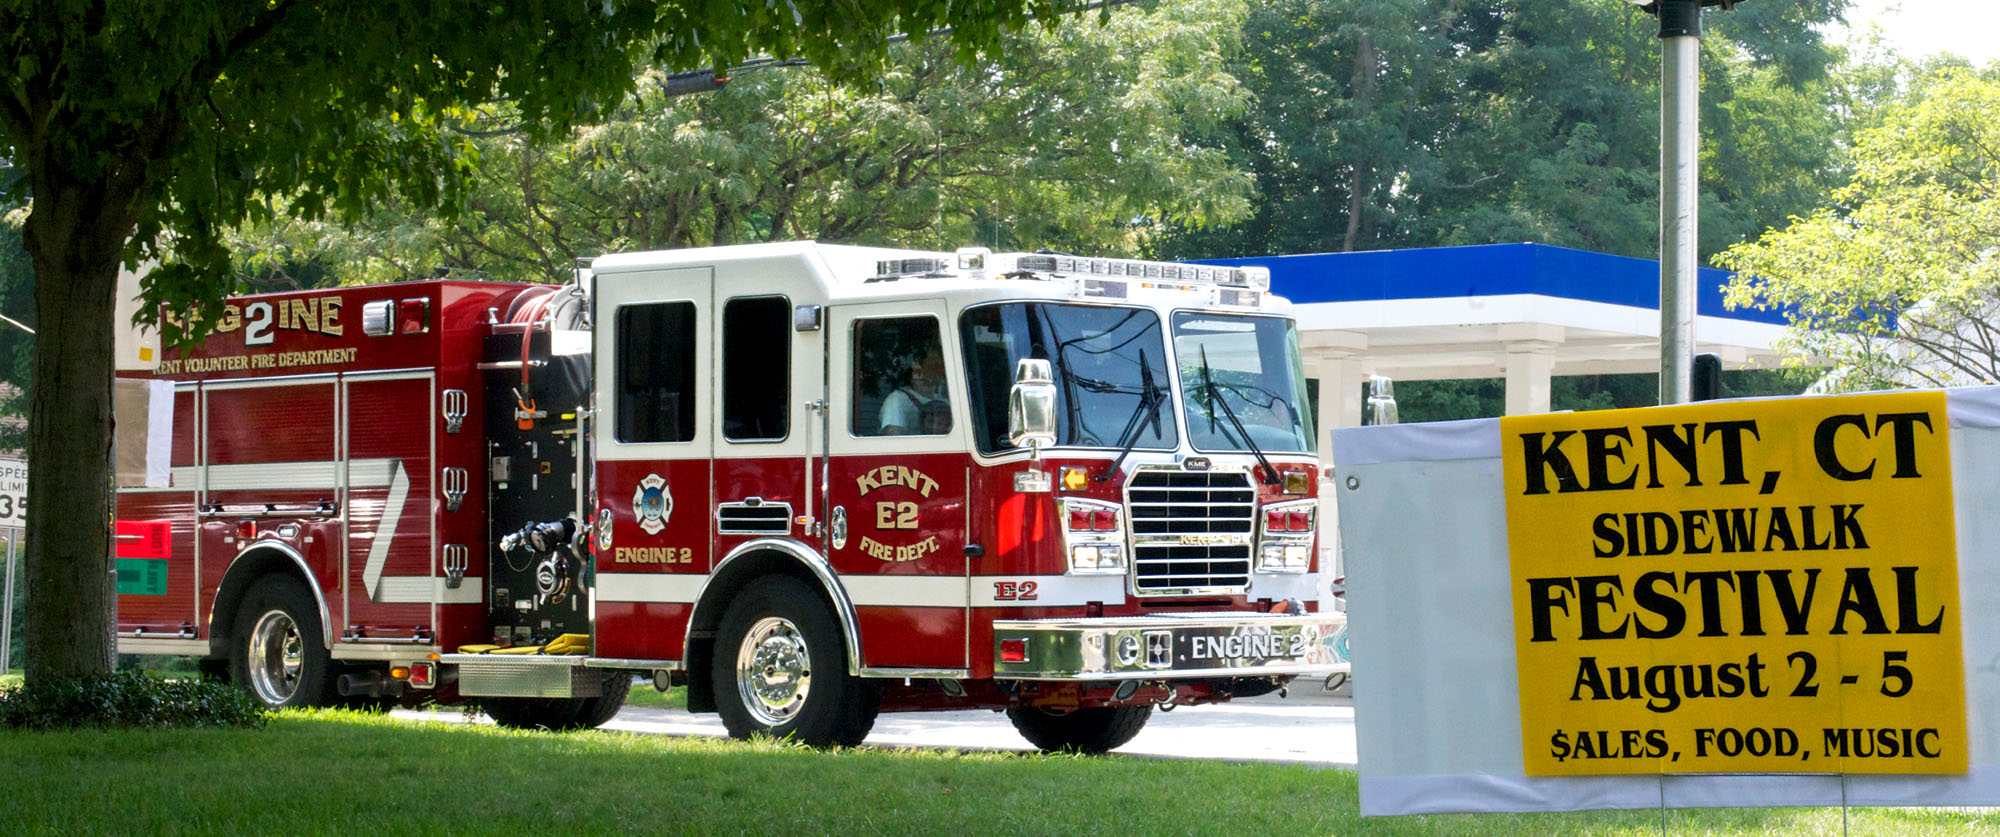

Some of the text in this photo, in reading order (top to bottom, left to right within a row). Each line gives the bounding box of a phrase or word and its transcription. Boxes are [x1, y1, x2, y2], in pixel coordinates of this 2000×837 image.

[184, 355, 249, 373] VOLUNTEER
[251, 353, 276, 369] FIRE
[278, 347, 358, 367] DEPARTMENT
[1519, 411, 1934, 496] KENT, CT
[0, 467, 28, 479] SPEE
[0, 481, 28, 492] LIMI
[856, 465, 940, 498] KENT
[876, 501, 919, 530] E2
[1592, 504, 1870, 559] SIDEWALK
[615, 547, 693, 564] ENGINE 2
[859, 536, 940, 562] FIRE DEPT.
[993, 581, 1038, 601] E2
[1526, 566, 1945, 642] FESTIVAL
[1192, 633, 1306, 660] ENGINE 2
[1569, 652, 1770, 713] August
[1787, 651, 1820, 698] 2
[1880, 650, 1914, 698] 5
[1550, 727, 1942, 762] $ALES, FOOD, MUSIC
